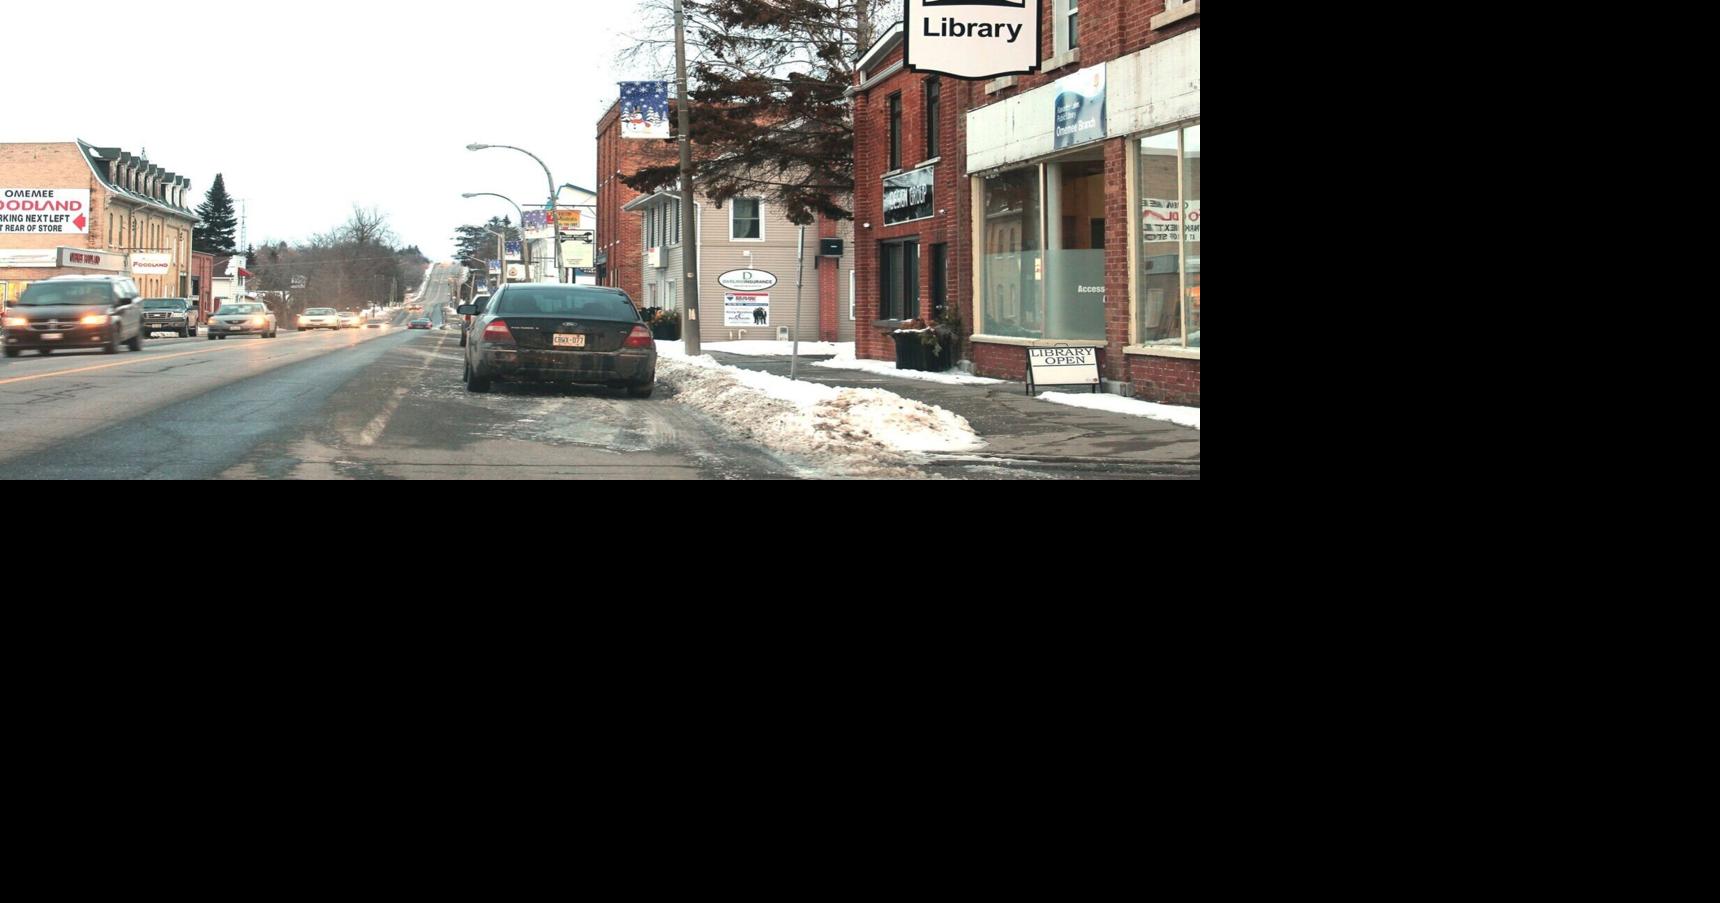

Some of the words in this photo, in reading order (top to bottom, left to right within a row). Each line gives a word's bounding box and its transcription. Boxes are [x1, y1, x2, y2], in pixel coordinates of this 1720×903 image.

[923, 17, 1023, 43] Library
[4, 190, 54, 198] OMEMEE
[25, 214, 49, 222] NEXT
[49, 214, 70, 222] LEFT
[5, 224, 25, 232] REAR
[26, 224, 37, 232] OF
[38, 224, 63, 232] STORE
[1031, 348, 1093, 357] LIBRARY
[1044, 356, 1086, 365] OPEN
